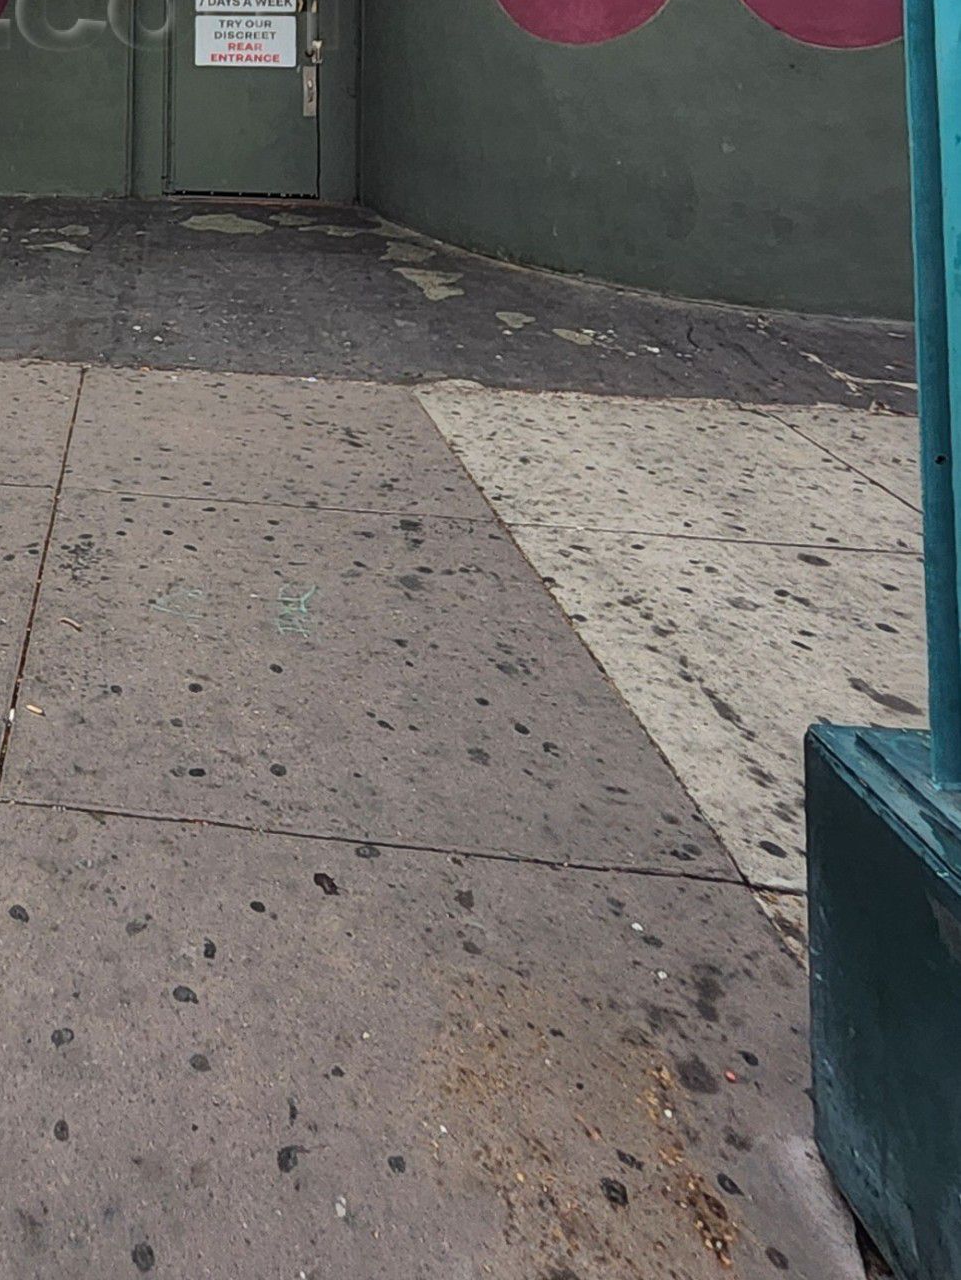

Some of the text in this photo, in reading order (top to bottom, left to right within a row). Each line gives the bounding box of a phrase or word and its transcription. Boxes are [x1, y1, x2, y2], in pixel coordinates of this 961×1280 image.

[219, 20, 272, 28] TRY OUR
[214, 31, 276, 40] DISCREET
[228, 42, 263, 51] REAR
[210, 54, 280, 63] ENTRANCE
